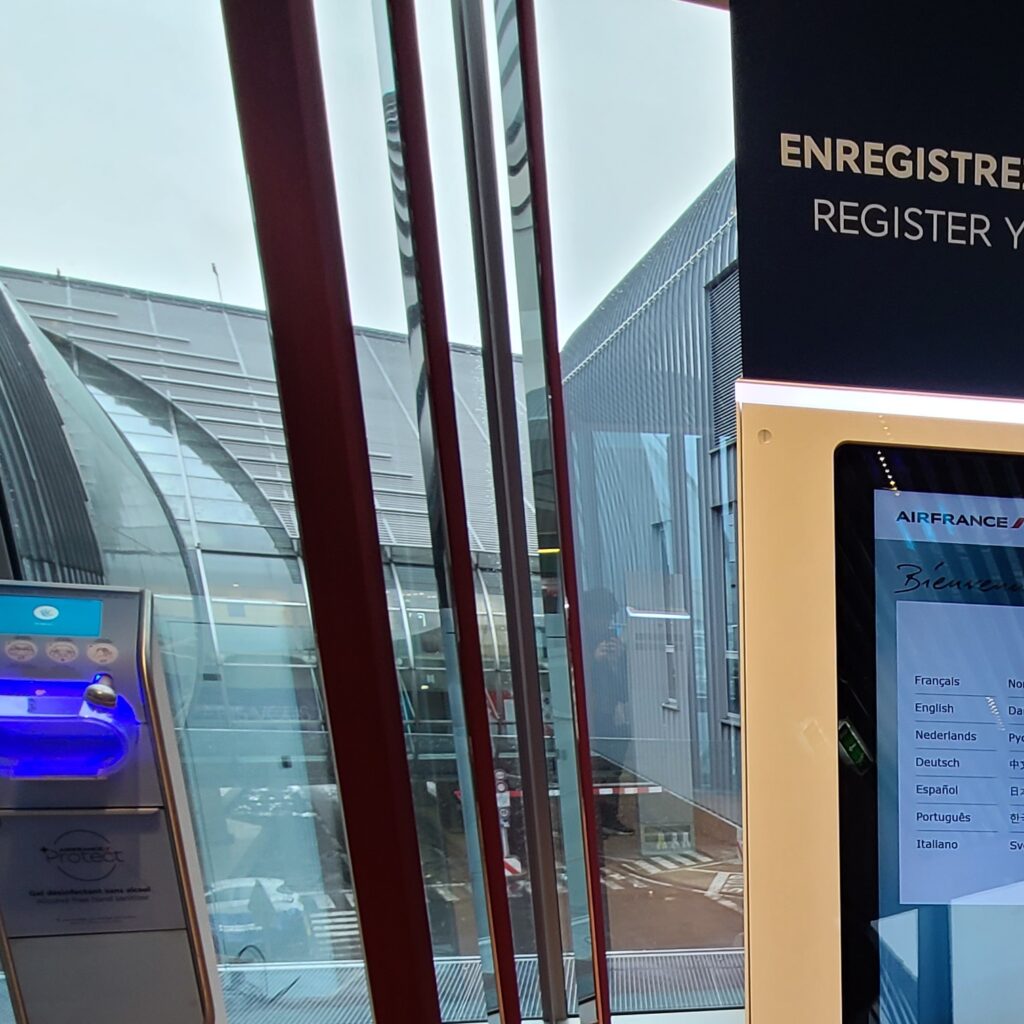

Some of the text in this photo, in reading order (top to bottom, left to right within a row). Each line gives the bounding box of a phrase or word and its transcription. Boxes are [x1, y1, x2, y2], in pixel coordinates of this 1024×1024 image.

[812, 197, 993, 248] REGISTER
[896, 510, 1009, 529] AIRFRANCE
[914, 675, 960, 688] Français
[914, 702, 954, 714] English
[915, 730, 977, 742] Nederlands
[915, 757, 960, 768] Deutsch
[916, 784, 959, 796] Español
[916, 811, 971, 824] Português
[916, 839, 959, 850] Italiano
